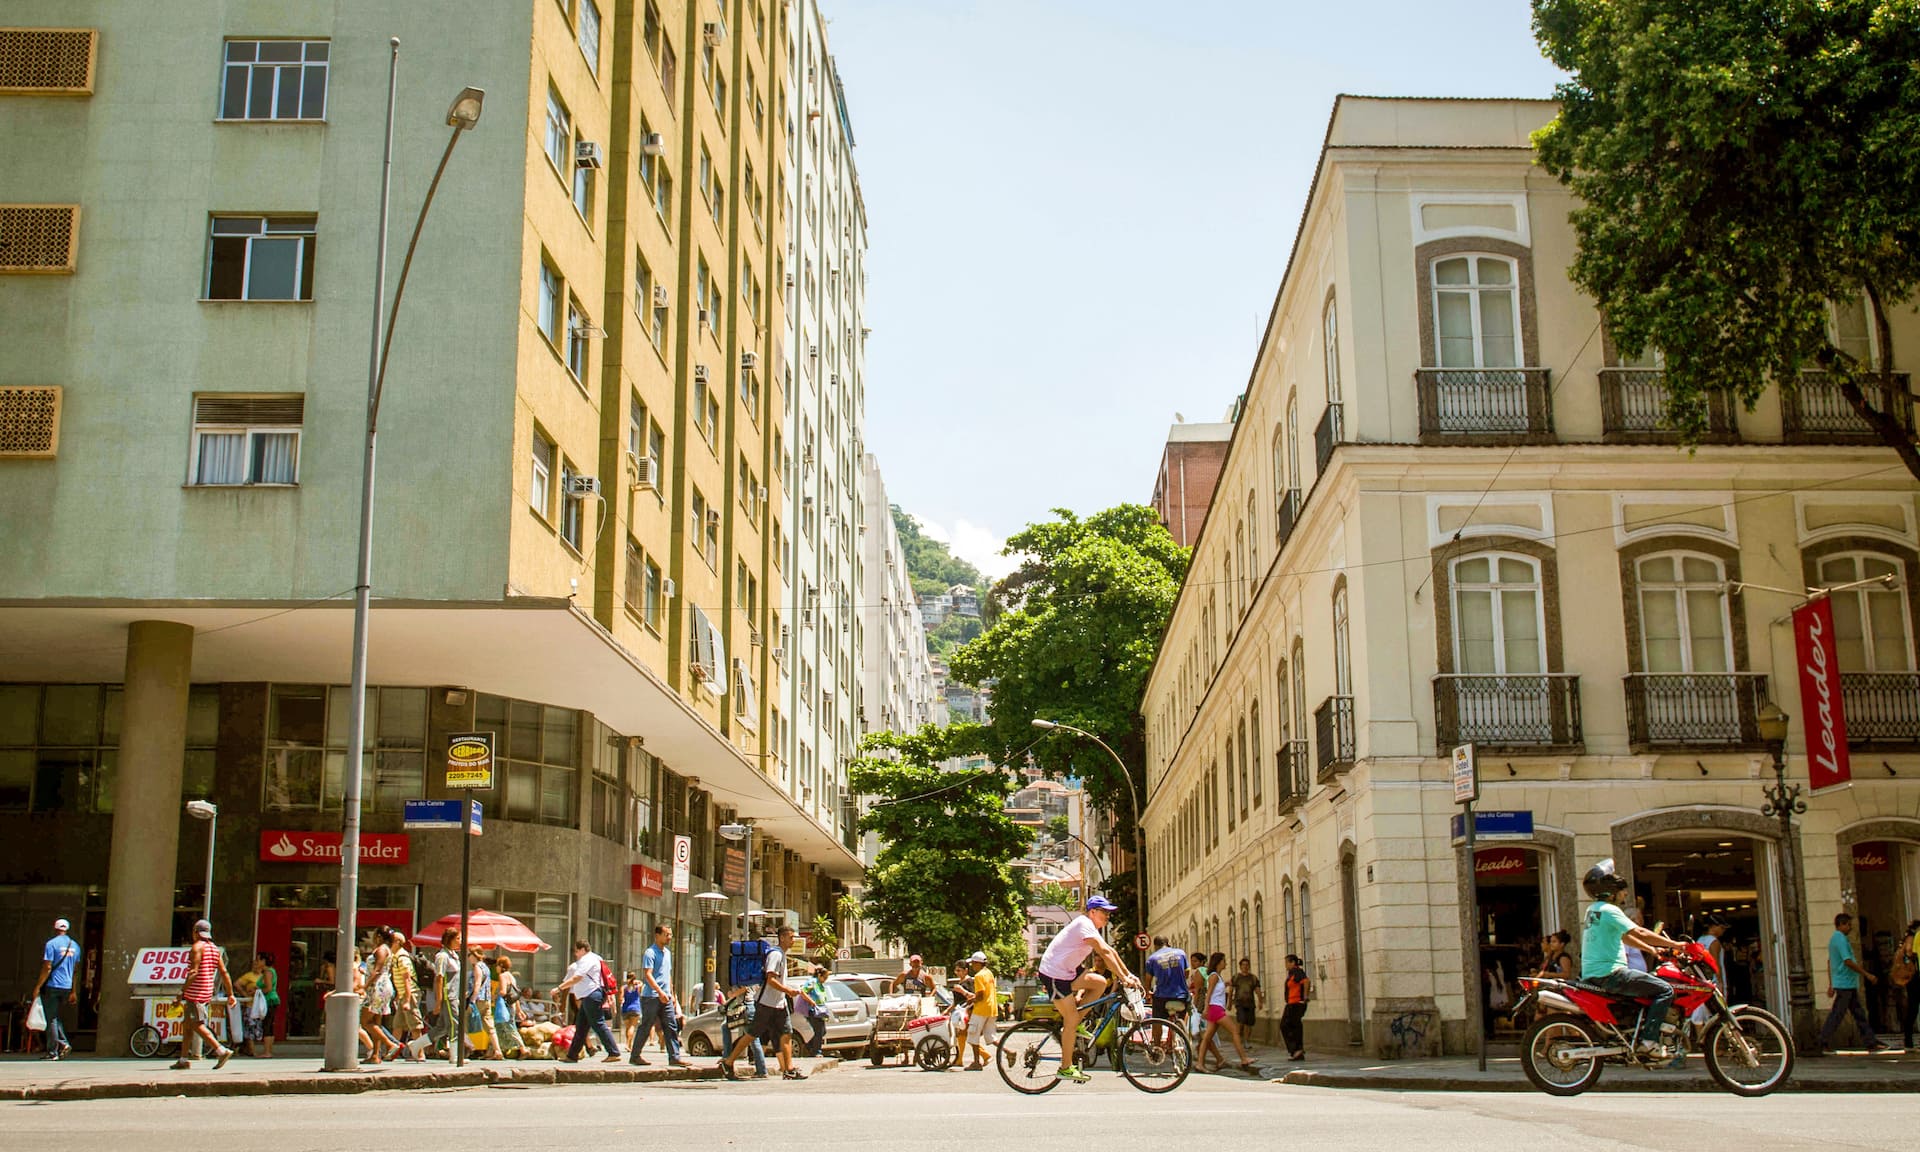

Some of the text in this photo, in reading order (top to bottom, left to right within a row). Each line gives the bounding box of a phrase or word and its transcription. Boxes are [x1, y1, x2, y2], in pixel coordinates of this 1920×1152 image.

[1806, 611, 1838, 774] Leader
[302, 839, 402, 858] Santnder
[1475, 856, 1523, 872] Leader
[1854, 851, 1887, 866] ader
[142, 951, 191, 964] CUSC
